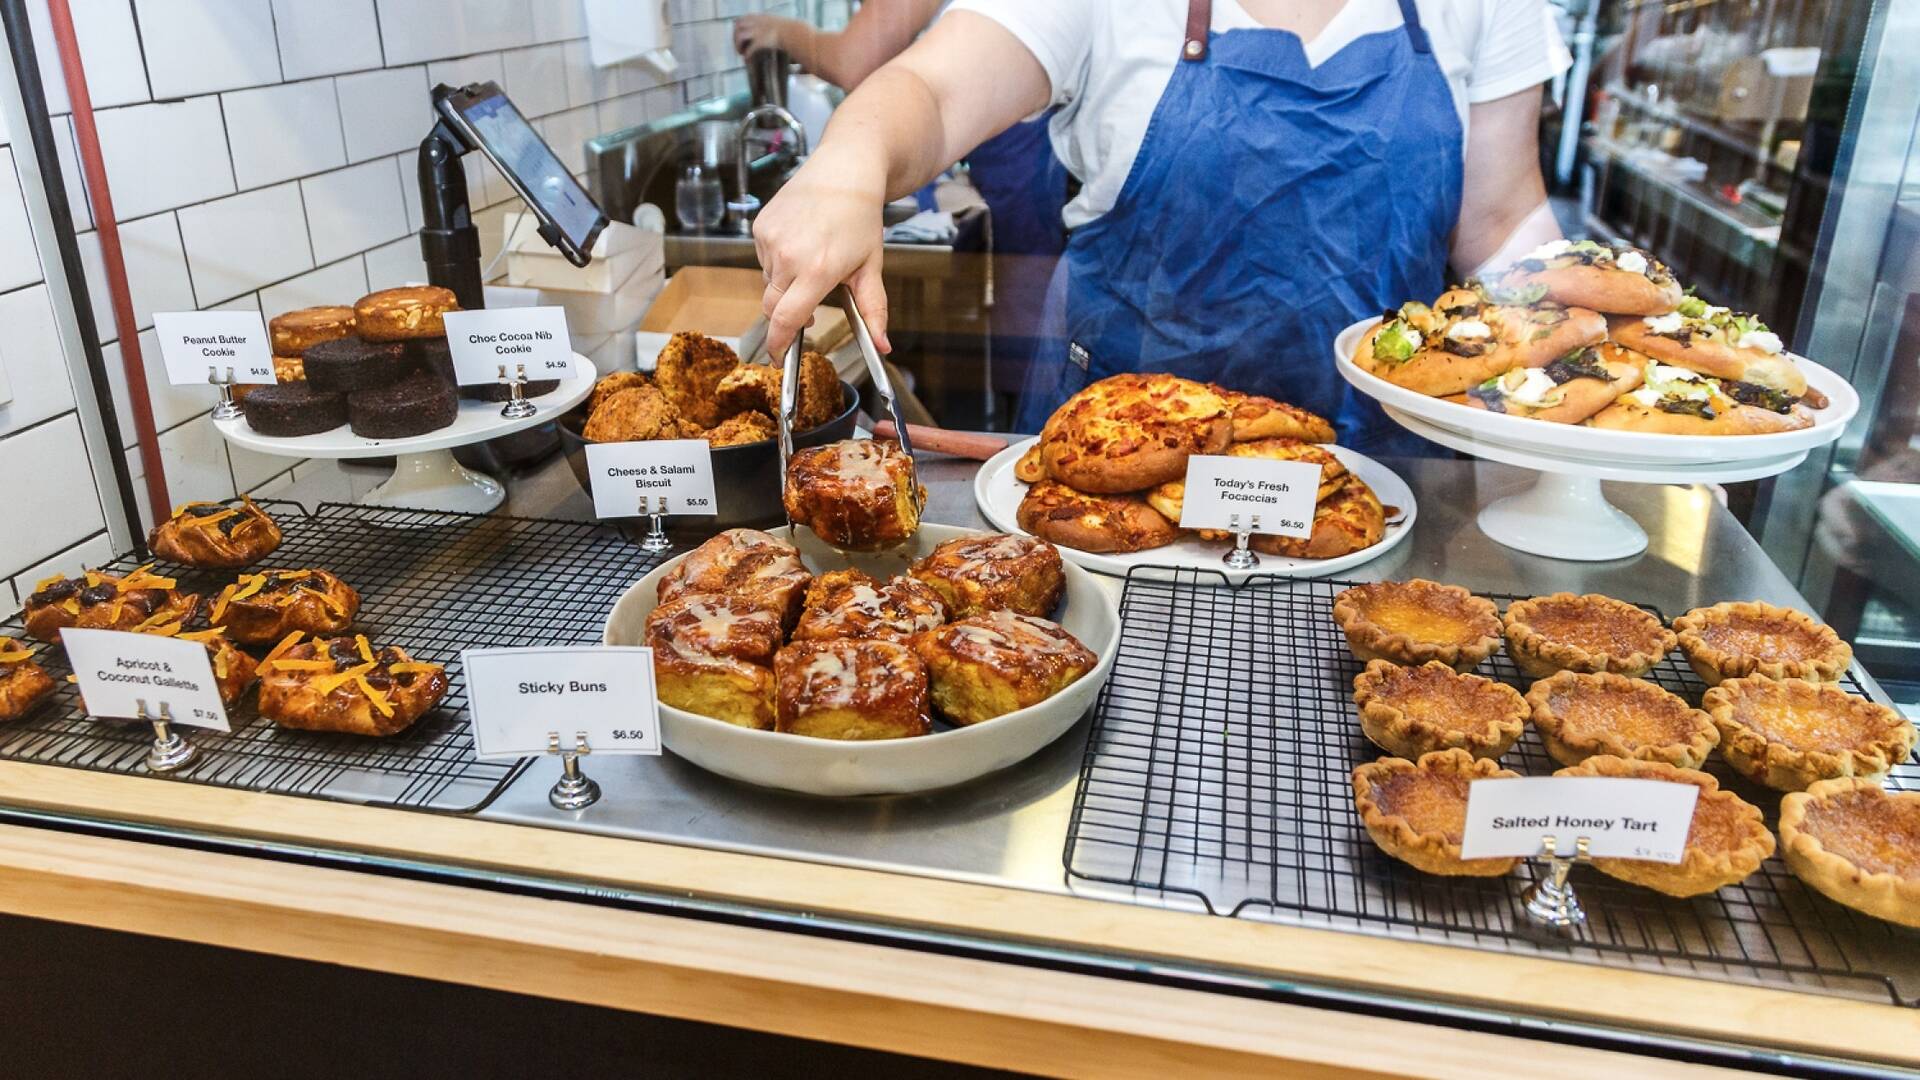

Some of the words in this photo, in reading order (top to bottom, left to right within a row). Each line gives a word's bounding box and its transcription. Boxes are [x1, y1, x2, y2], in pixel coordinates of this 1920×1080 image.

[183, 335, 217, 345] Peanut
[219, 334, 247, 344] Butter
[469, 334, 497, 344] Choc
[499, 332, 533, 342] Cocoa
[535, 330, 553, 340] Nib
[202, 347, 236, 357] Cookie
[495, 344, 532, 354] Cookie
[545, 360, 567, 369] $4.50
[250, 367, 270, 376] $4.50
[607, 467, 648, 477] Cheese
[649, 465, 658, 475] &
[659, 464, 696, 475] Salami
[635, 478, 672, 489] Biscuit
[1213, 477, 1255, 490] Today's
[1257, 480, 1290, 493] Fresh
[686, 498, 708, 507] $5.50
[1220, 491, 1278, 504] Focaccias
[1280, 518, 1305, 530] $6.50
[116, 656, 161, 673] Apricot
[163, 661, 173, 673] &
[96, 670, 151, 685] Coconut
[518, 681, 565, 695] Sticky
[569, 680, 608, 693] Buns
[192, 708, 219, 722] $7.50
[612, 729, 644, 740] $6.50
[1492, 816, 1550, 830] Salted
[1555, 815, 1616, 831] Honey
[1621, 816, 1658, 833] Tart
